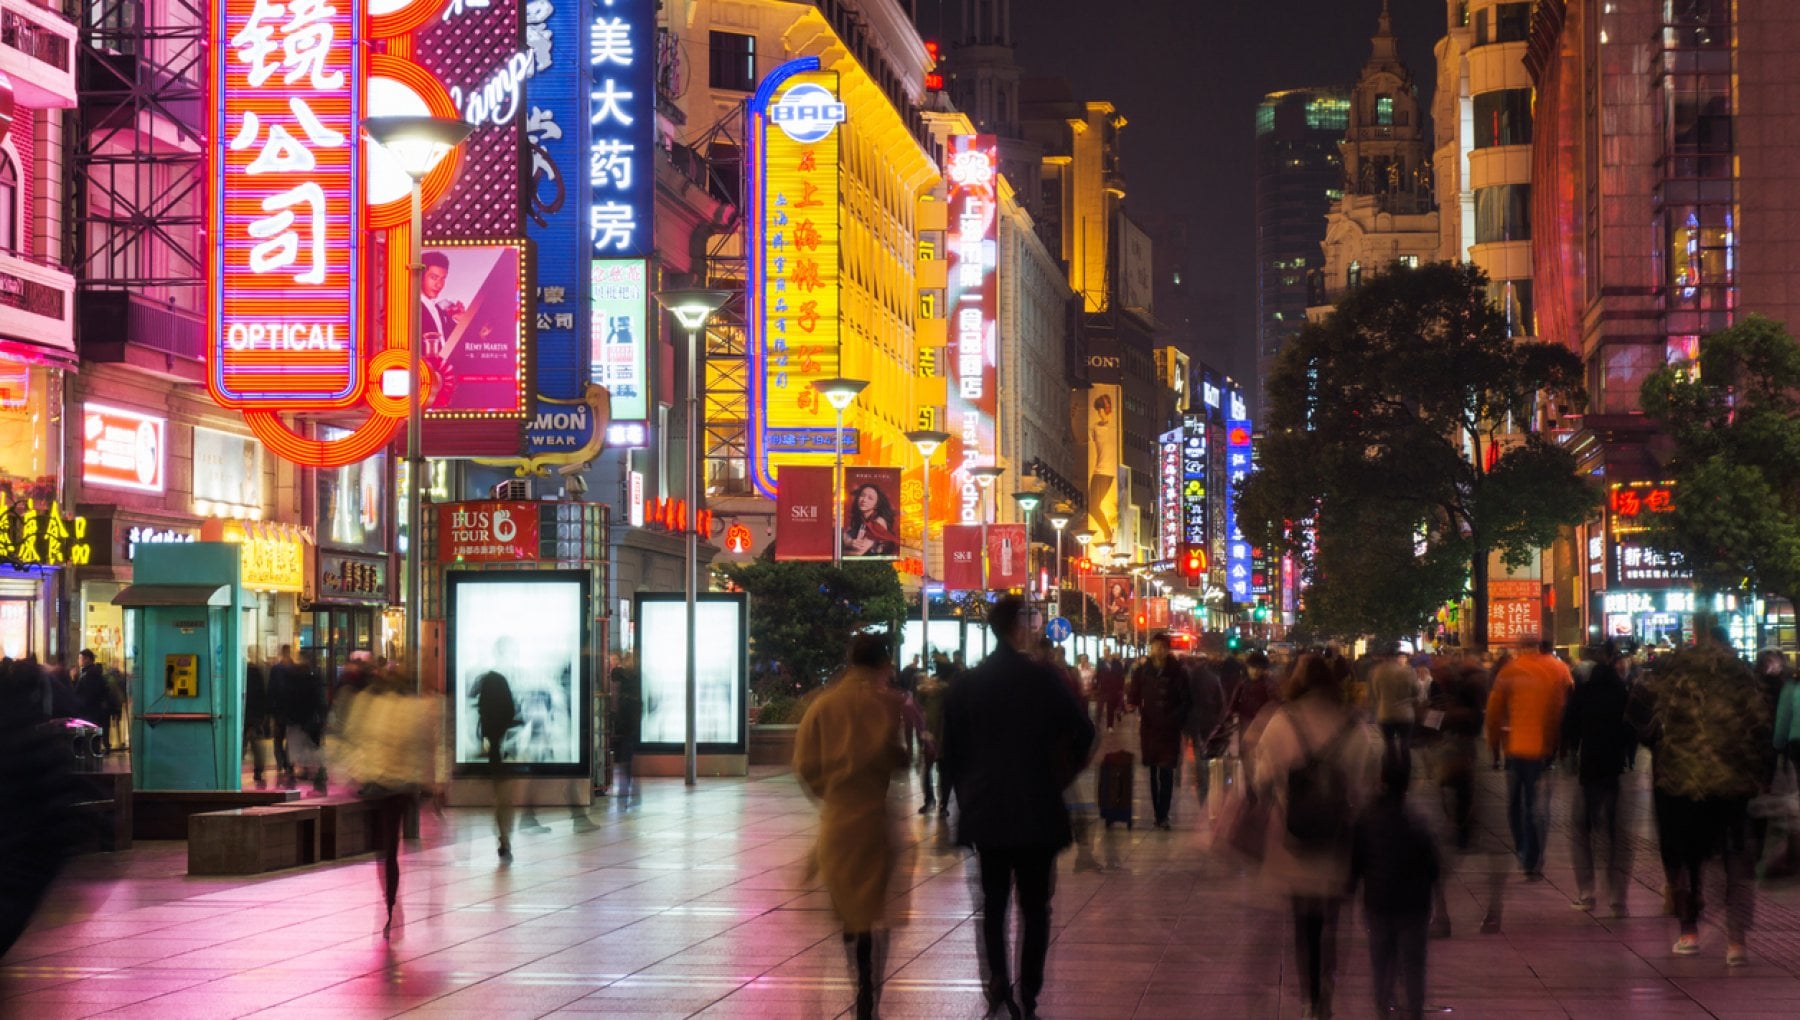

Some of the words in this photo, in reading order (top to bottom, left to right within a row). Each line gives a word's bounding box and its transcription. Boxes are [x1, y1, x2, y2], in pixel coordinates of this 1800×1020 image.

[773, 104, 844, 121] BAC
[590, 0, 636, 250] 美大药房
[536, 286, 566, 304] 蒙
[536, 312, 574, 330] 公司
[228, 322, 343, 352] OPTICAL
[962, 411, 980, 446] First
[532, 435, 577, 446] WEAR
[452, 512, 489, 528] BUS
[452, 530, 490, 542] TOUR
[1508, 624, 1538, 634] SALE
